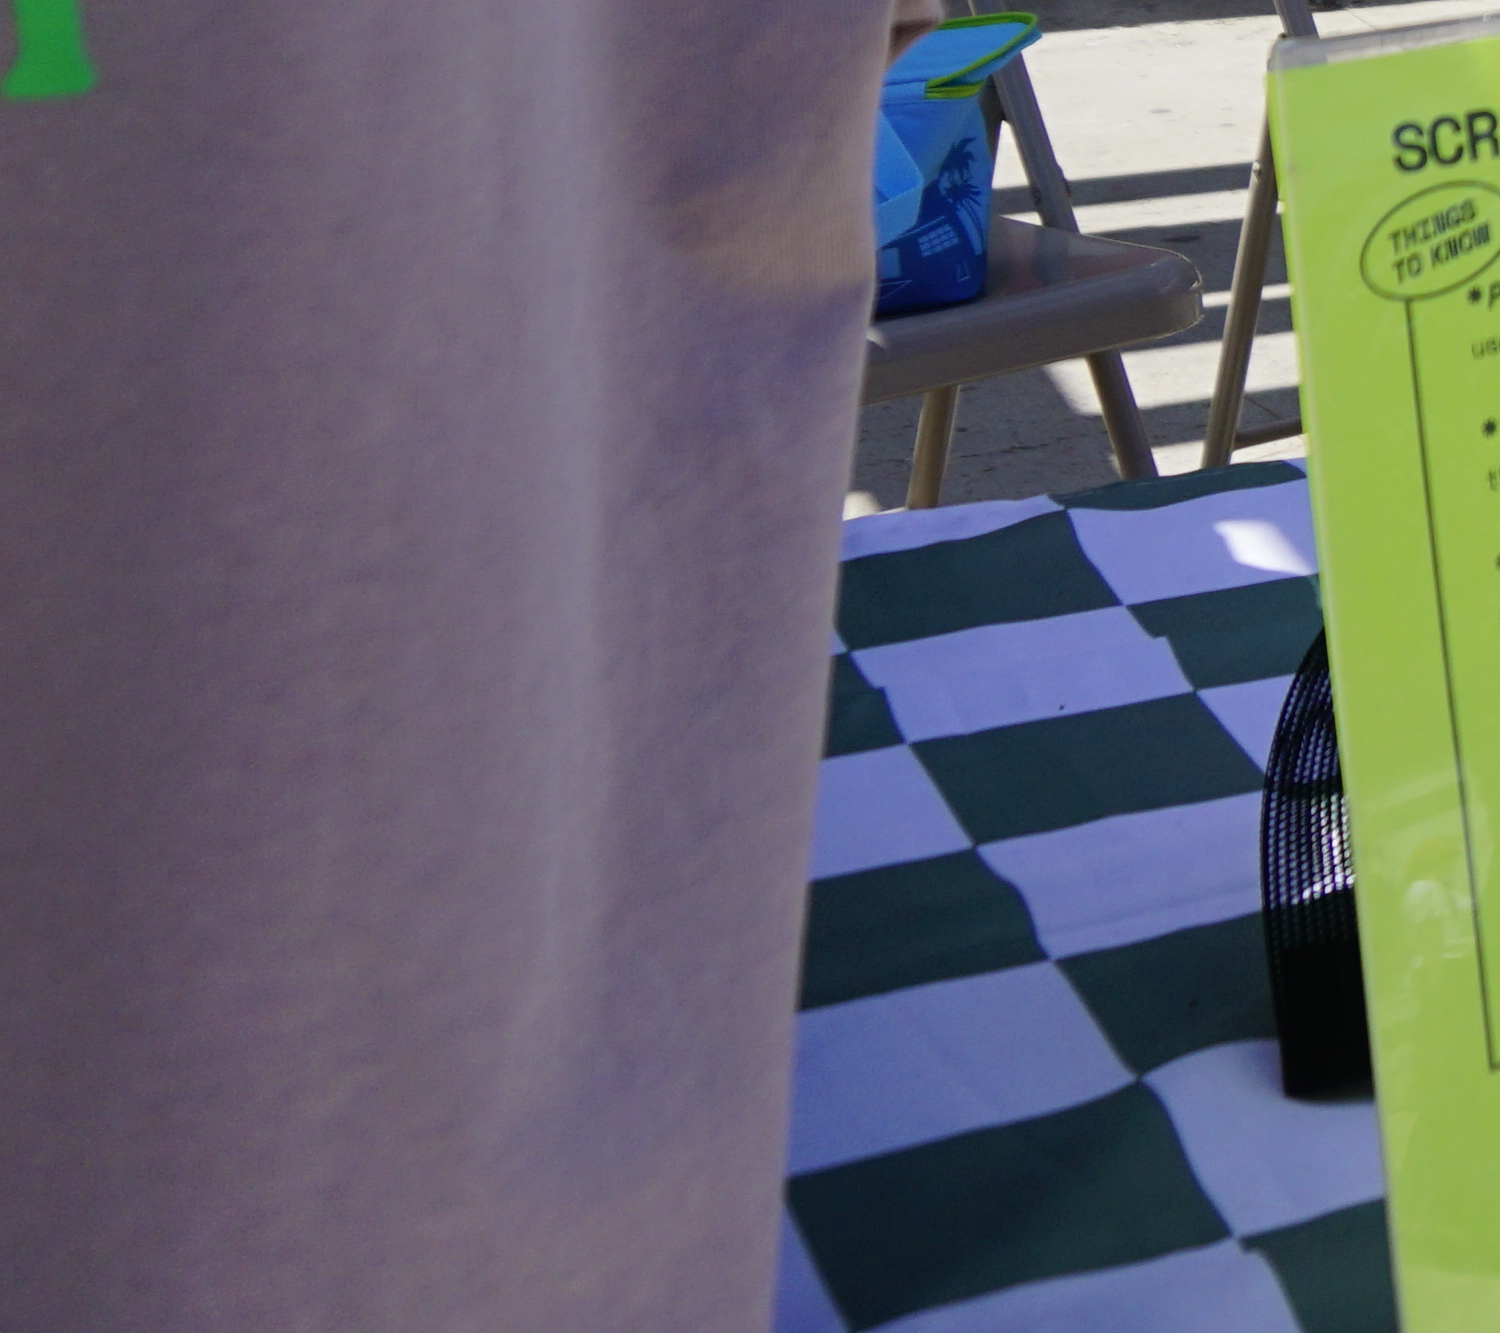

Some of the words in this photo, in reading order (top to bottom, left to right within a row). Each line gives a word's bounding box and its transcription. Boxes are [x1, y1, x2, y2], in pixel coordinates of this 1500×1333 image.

[1388, 198, 1477, 257] THINGS
[1391, 254, 1422, 285] TO
[1429, 221, 1491, 273] KNOW
